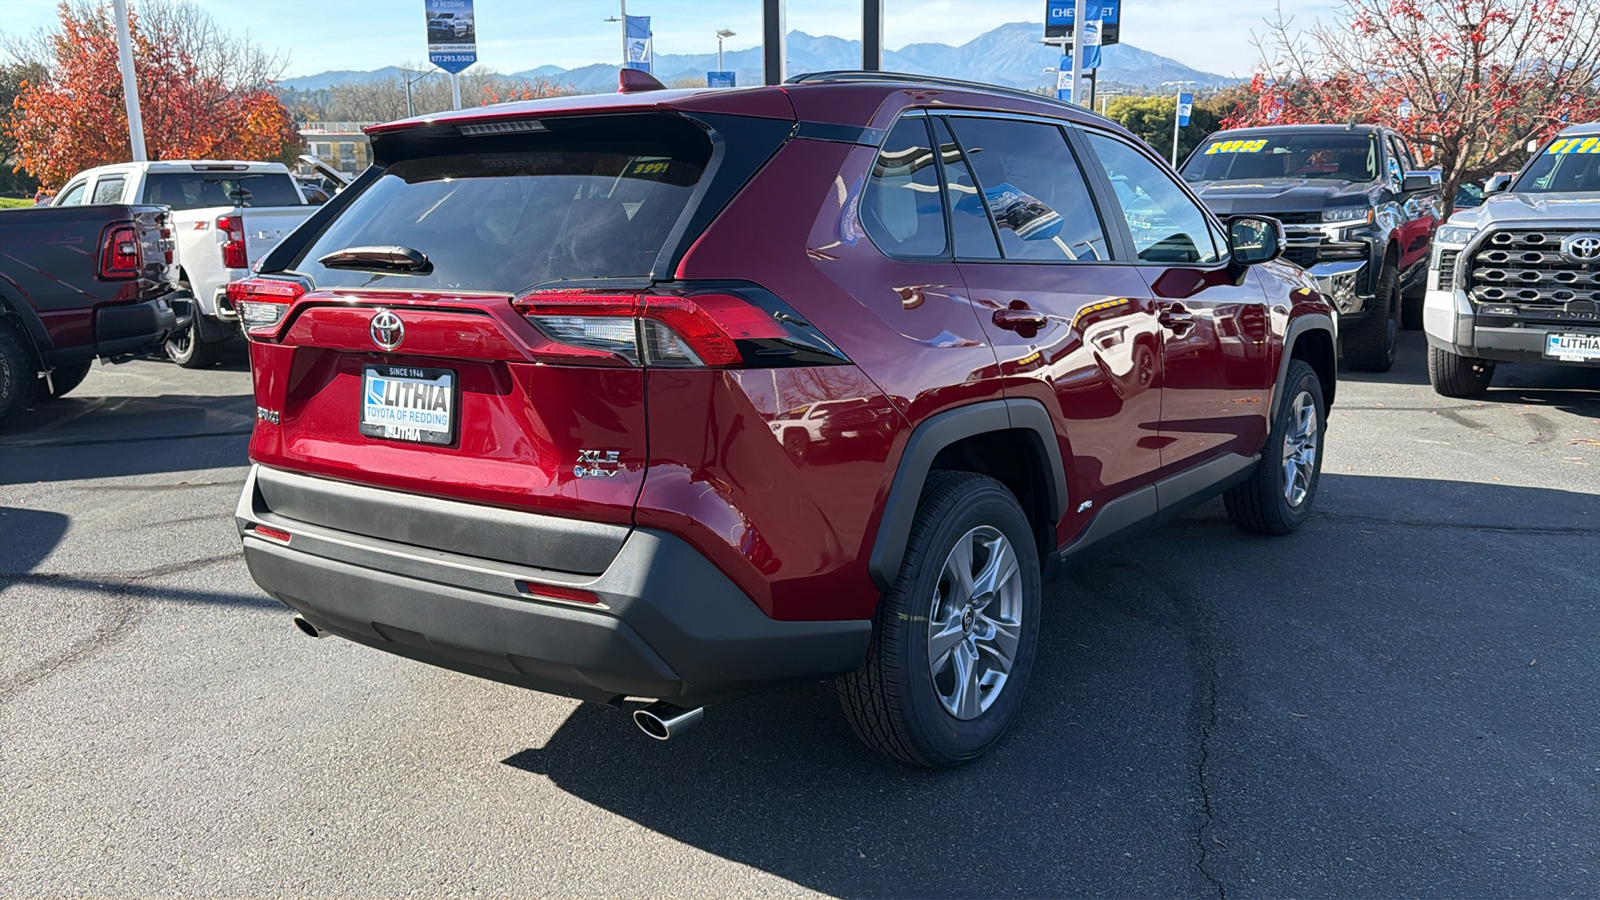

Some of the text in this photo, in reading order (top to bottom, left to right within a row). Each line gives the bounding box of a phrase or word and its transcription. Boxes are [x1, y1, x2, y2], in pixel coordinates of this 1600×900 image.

[1560, 338, 1600, 349] LITHIA
[389, 367, 424, 378] SINCE 1946
[384, 381, 448, 412] LITHIA
[367, 406, 448, 425] TOYOTA OF REDDING
[576, 449, 620, 463] XLE
[583, 468, 619, 477] HEV
